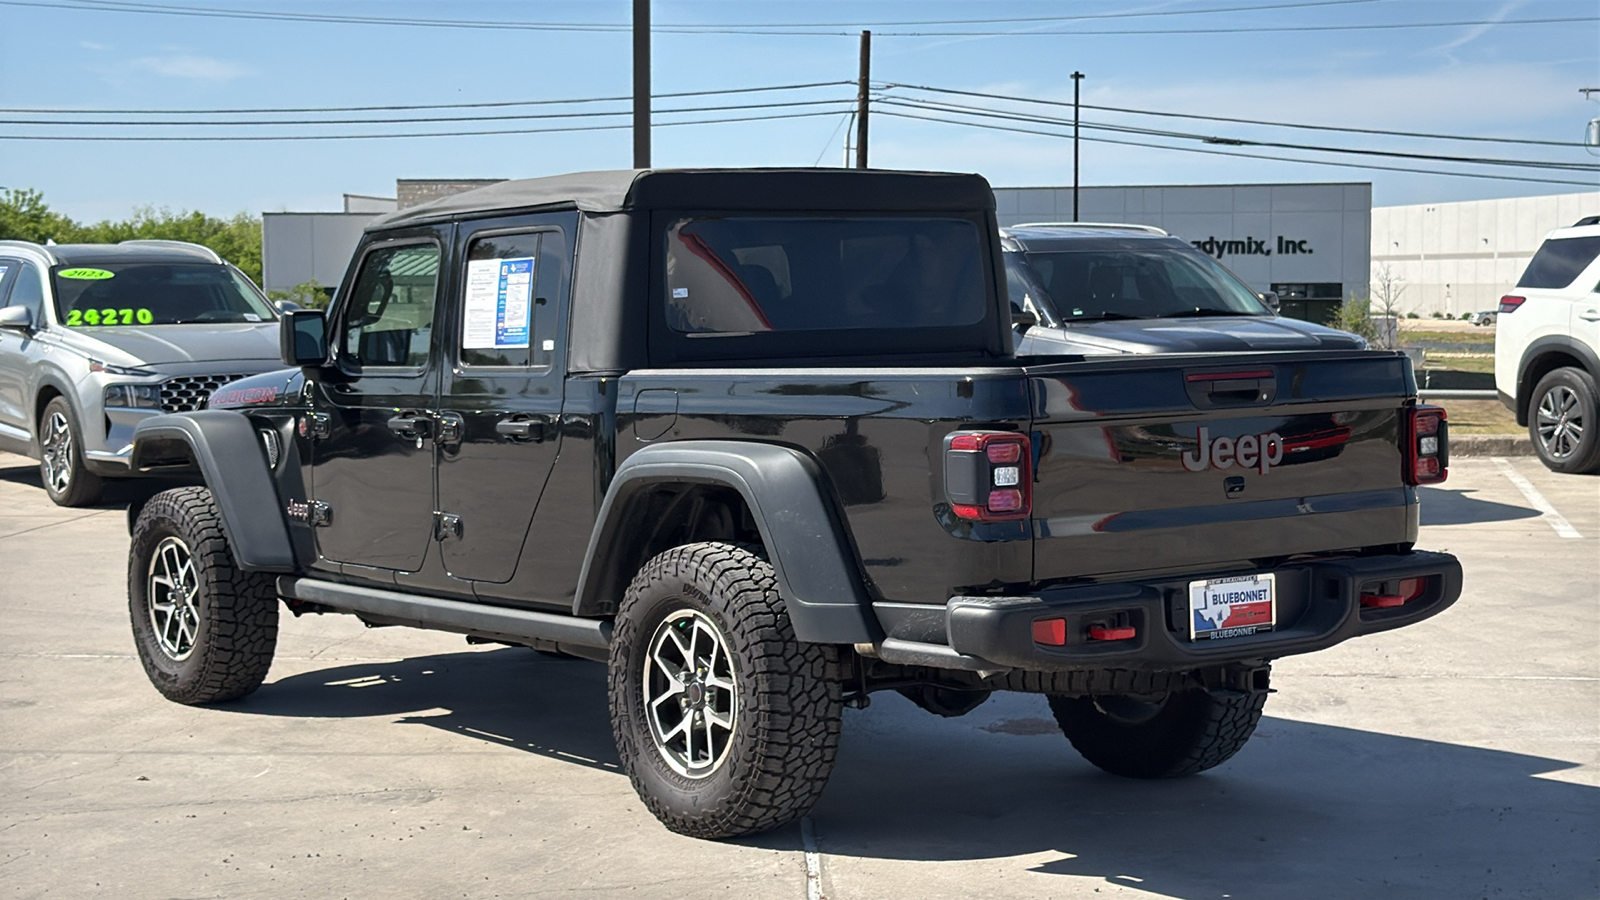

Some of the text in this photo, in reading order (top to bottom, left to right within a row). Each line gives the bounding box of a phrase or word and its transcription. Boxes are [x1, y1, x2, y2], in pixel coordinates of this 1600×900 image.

[1277, 236, 1314, 254] Inc.
[68, 270, 105, 278] 2023
[66, 308, 154, 326] 24270
[209, 386, 278, 406] RUBICON
[1181, 426, 1284, 475] Jeep
[287, 498, 308, 521] Jeep
[1212, 589, 1268, 605] BLUEBONNET
[1210, 626, 1257, 640] BLUEBONNET
